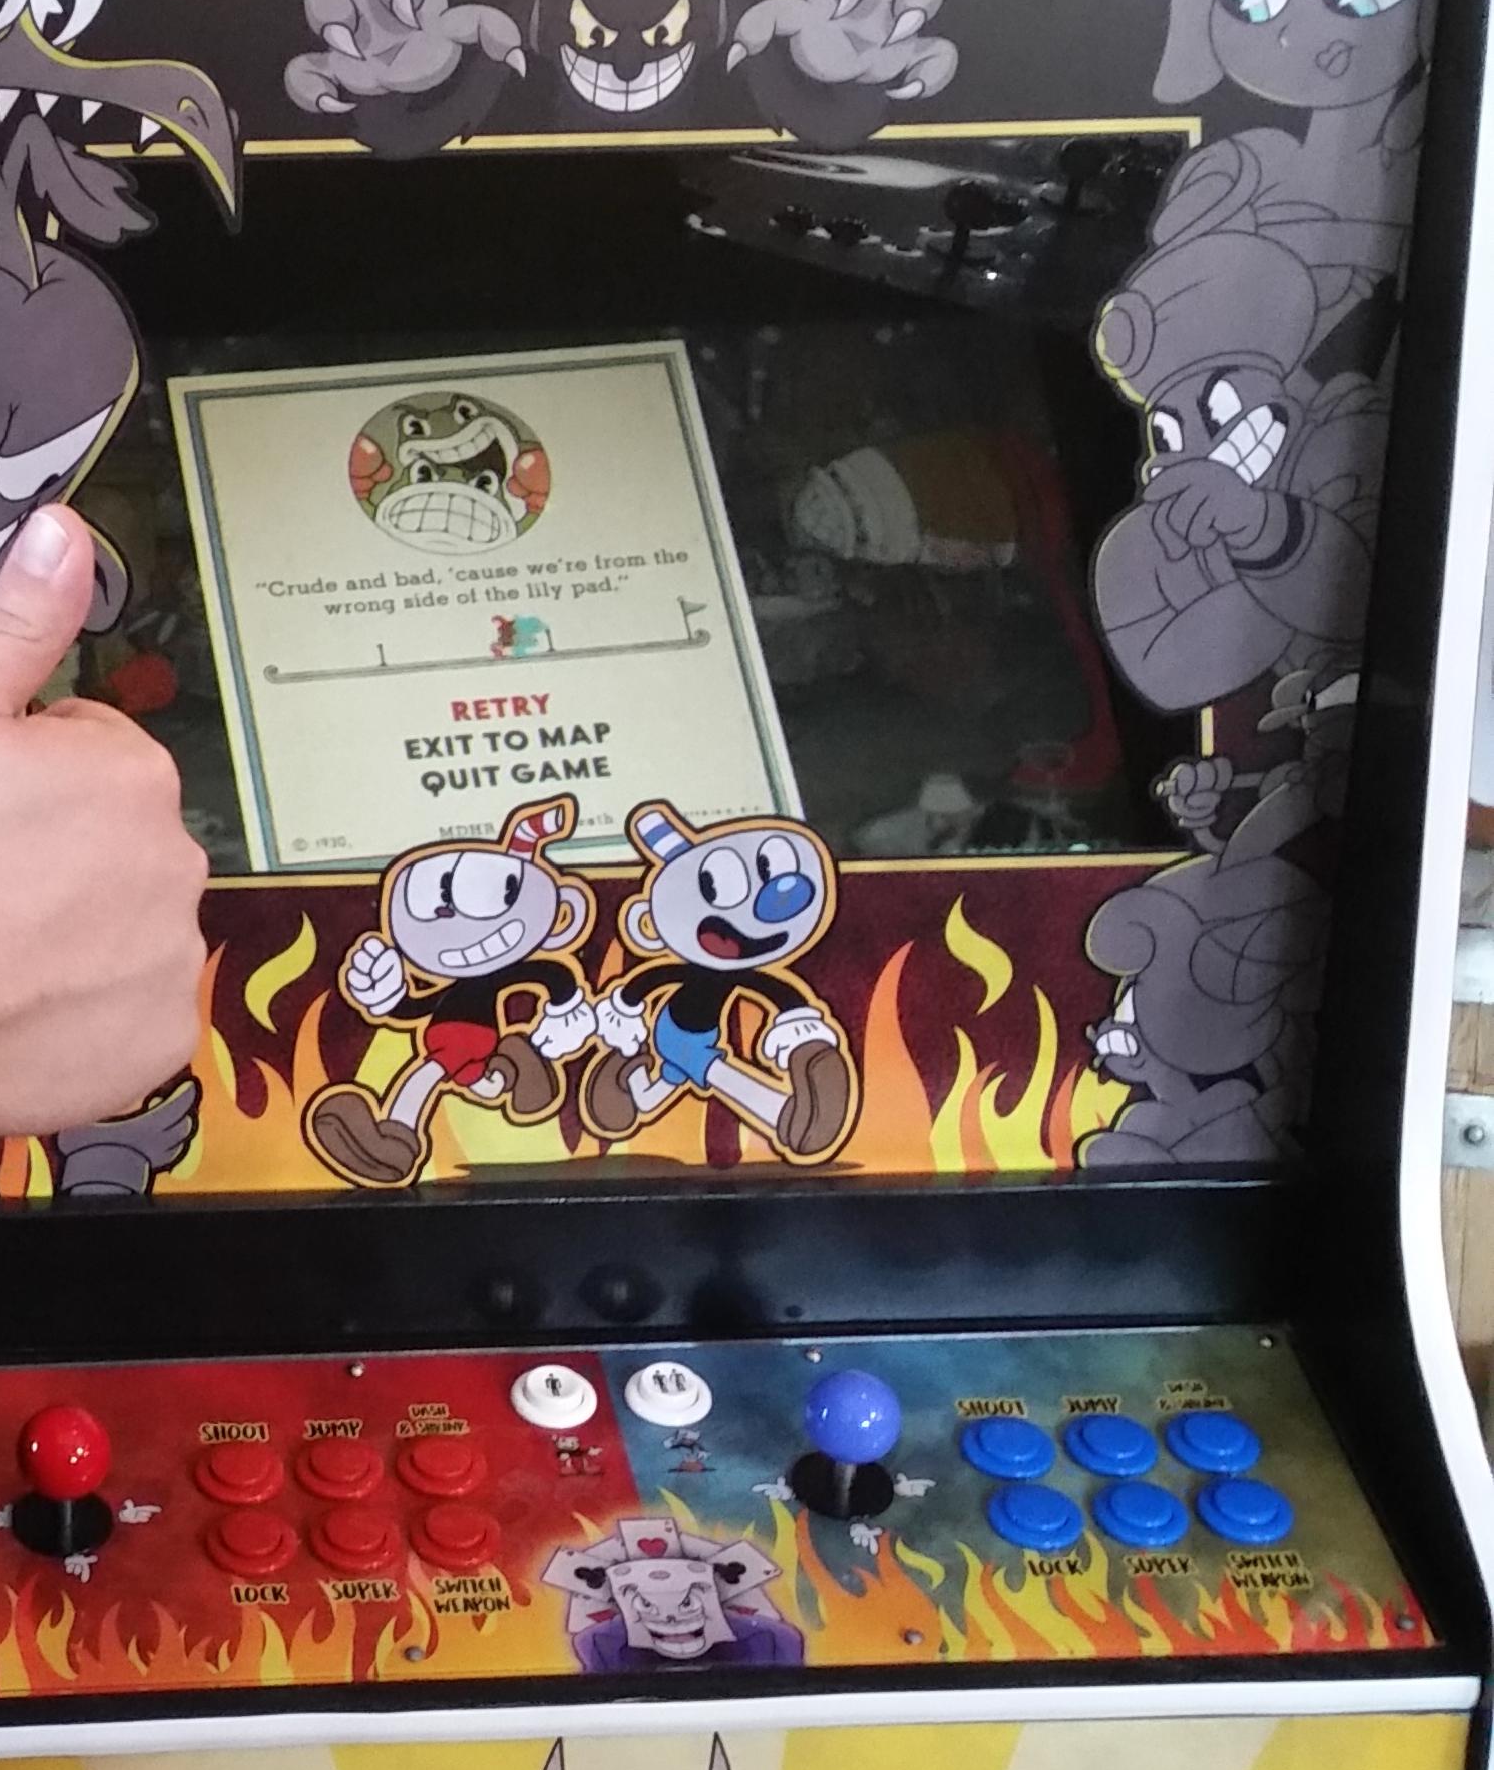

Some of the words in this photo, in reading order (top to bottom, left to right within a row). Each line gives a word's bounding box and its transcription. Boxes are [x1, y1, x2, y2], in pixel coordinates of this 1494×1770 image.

[255, 579, 338, 598] "Crude
[346, 573, 387, 591] and
[395, 569, 442, 588] bad,
[447, 564, 519, 583] 'cause
[526, 557, 588, 576] we're
[594, 552, 646, 571] from
[654, 548, 689, 566] the
[324, 598, 396, 616] wrong
[404, 592, 449, 610] side
[456, 588, 479, 606] of
[485, 585, 520, 603] the
[527, 580, 563, 602] lily
[450, 693, 550, 722] RETRY
[404, 734, 473, 760] EXIT
[483, 730, 529, 753] TO
[538, 722, 611, 749] MAP
[420, 765, 500, 798] QUIT
[510, 755, 612, 784] GAME
[957, 1399, 1026, 1416] SHOOT
[201, 1423, 268, 1441] SHOOT
[307, 1421, 361, 1438] JUMP
[1027, 1558, 1083, 1576] LOCK
[1229, 1552, 1300, 1569] SWITCH
[233, 1585, 287, 1603] LOCK
[331, 1582, 398, 1601] SUPER
[434, 1577, 503, 1594] SWITCH
[434, 1595, 511, 1614] WEAPON
